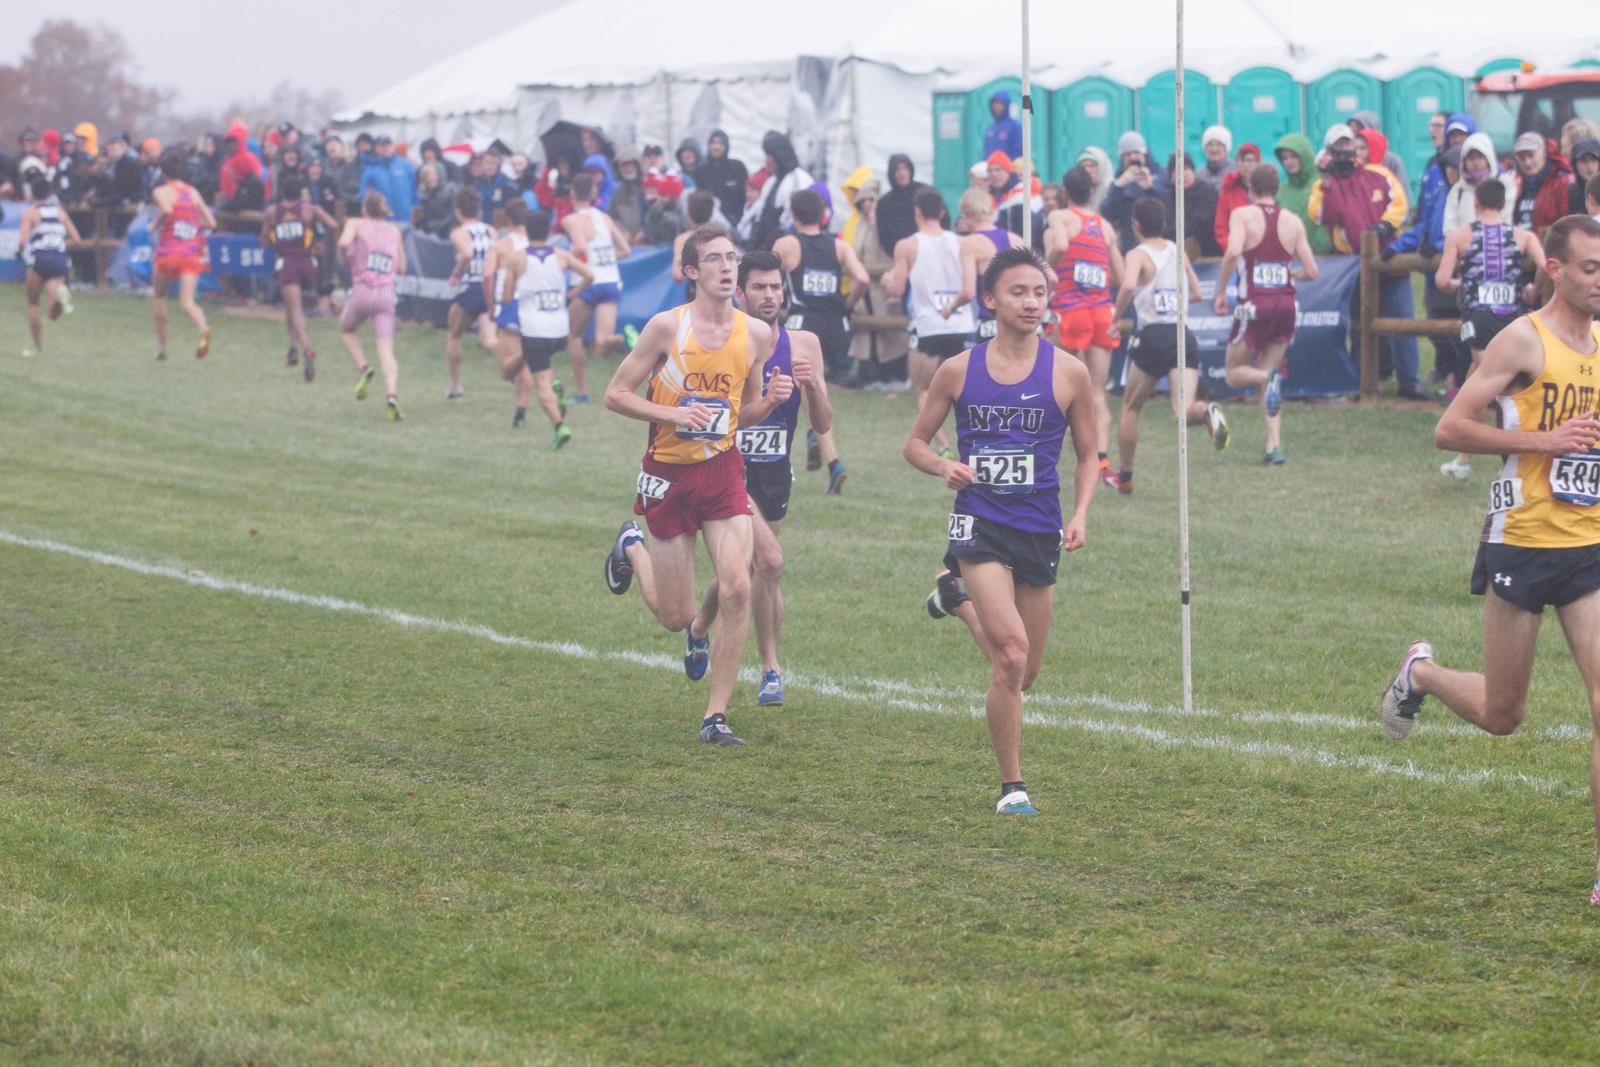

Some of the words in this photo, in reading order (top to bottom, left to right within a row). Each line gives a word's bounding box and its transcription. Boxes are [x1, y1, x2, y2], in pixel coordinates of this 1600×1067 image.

[1256, 267, 1283, 283] 496
[1482, 286, 1510, 304] 700
[683, 372, 732, 393] CMS
[967, 404, 1045, 434] NYU
[740, 431, 781, 454] 524
[975, 456, 1028, 484] 525
[1555, 461, 1600, 496] 589
[1490, 479, 1515, 510] 89
